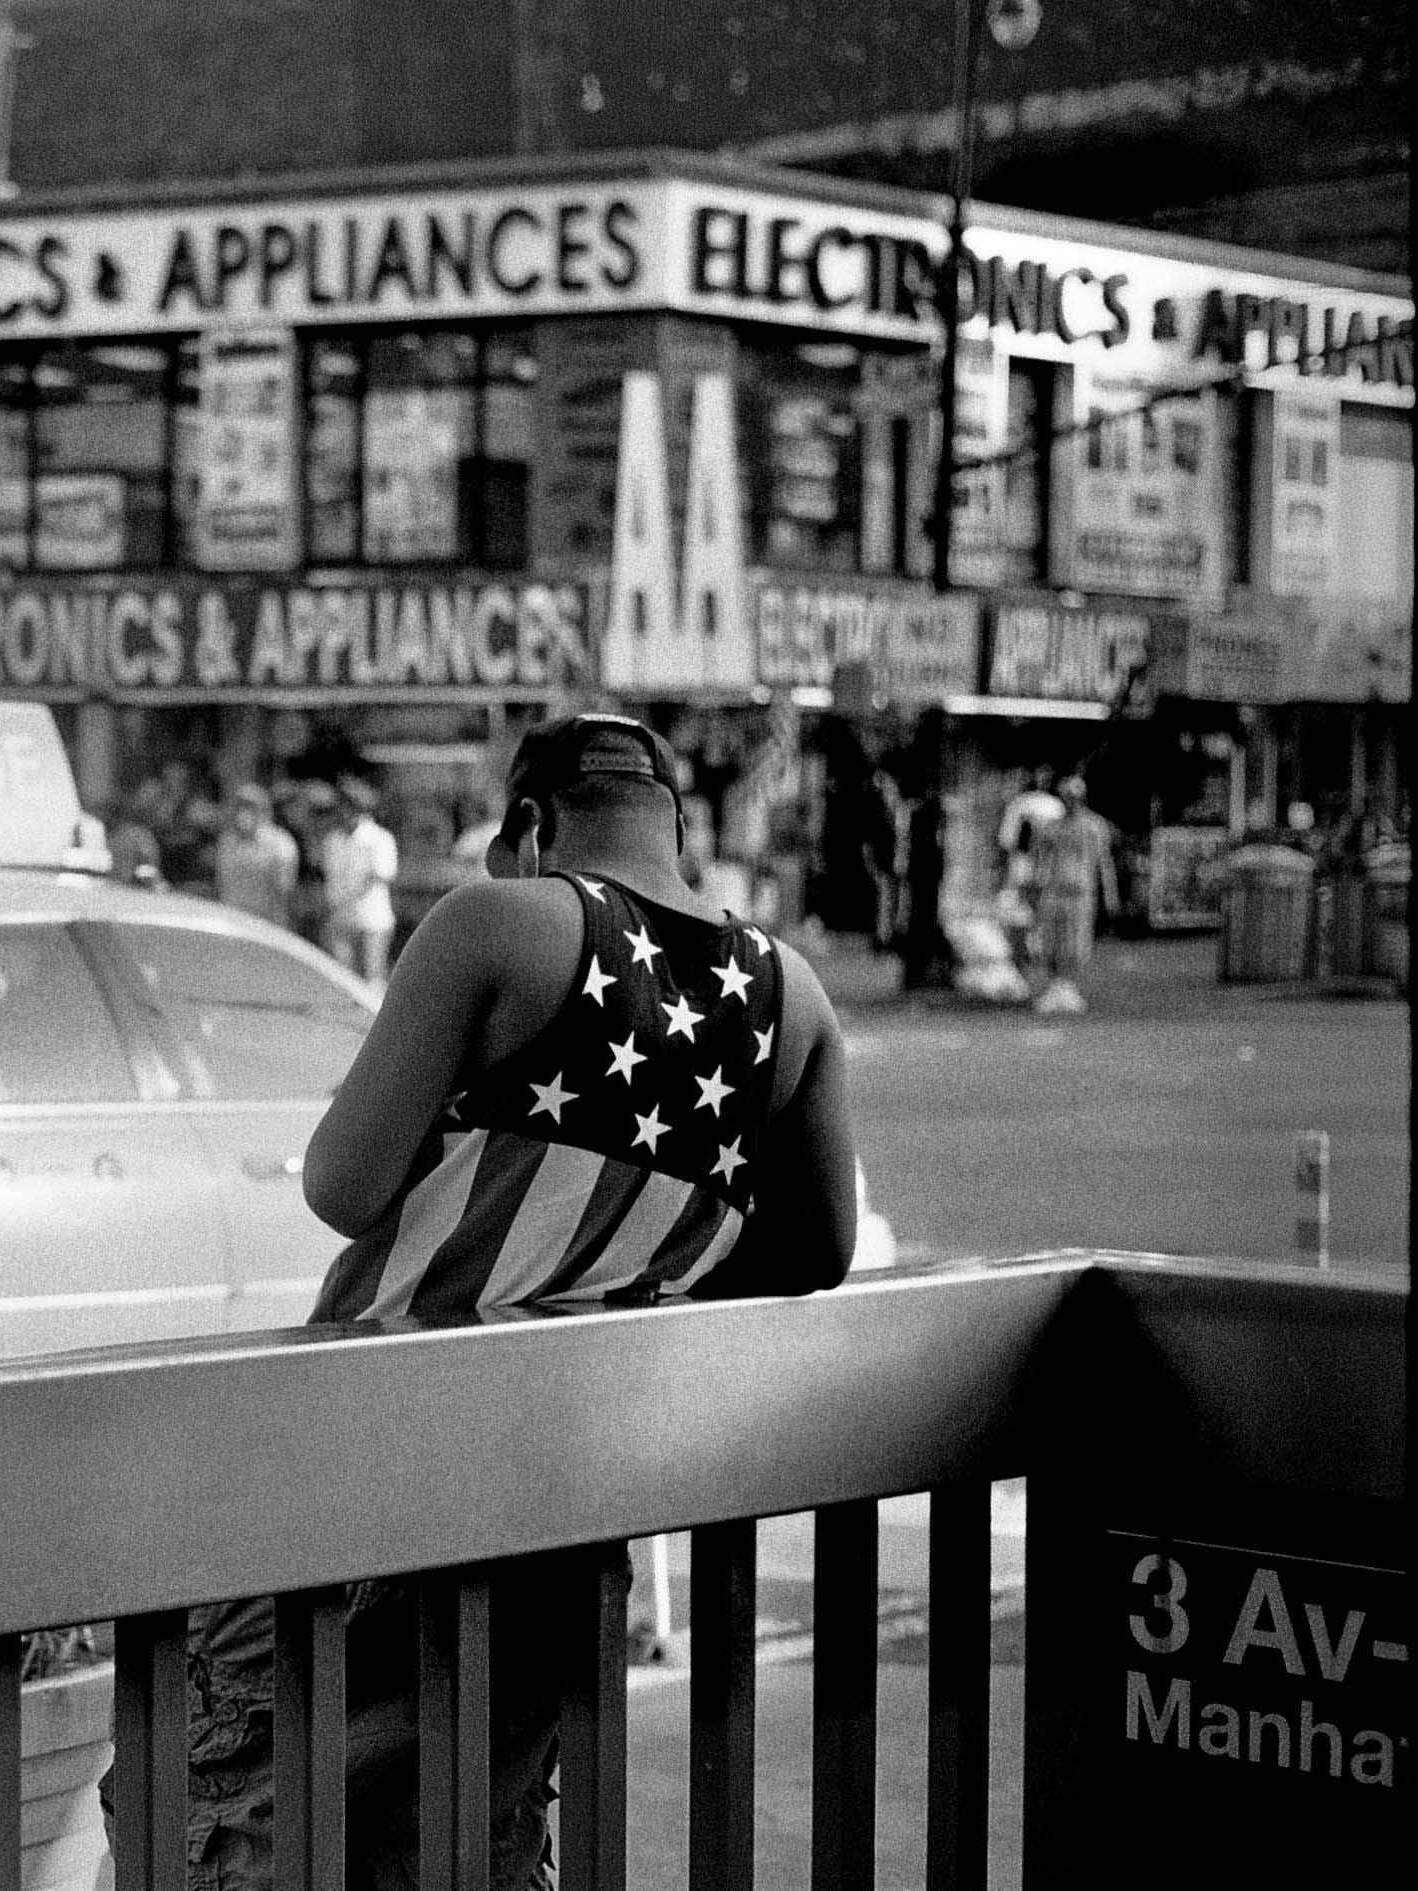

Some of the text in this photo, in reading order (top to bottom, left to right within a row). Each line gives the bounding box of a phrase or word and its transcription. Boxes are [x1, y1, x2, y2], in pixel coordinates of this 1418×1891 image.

[157, 200, 638, 313] APPLIANCES
[696, 207, 1130, 348] ELECTRONICS
[247, 586, 580, 686] APPLIANCES
[1128, 1553, 1190, 1653] 3
[1126, 1669, 1409, 1787] Manha
